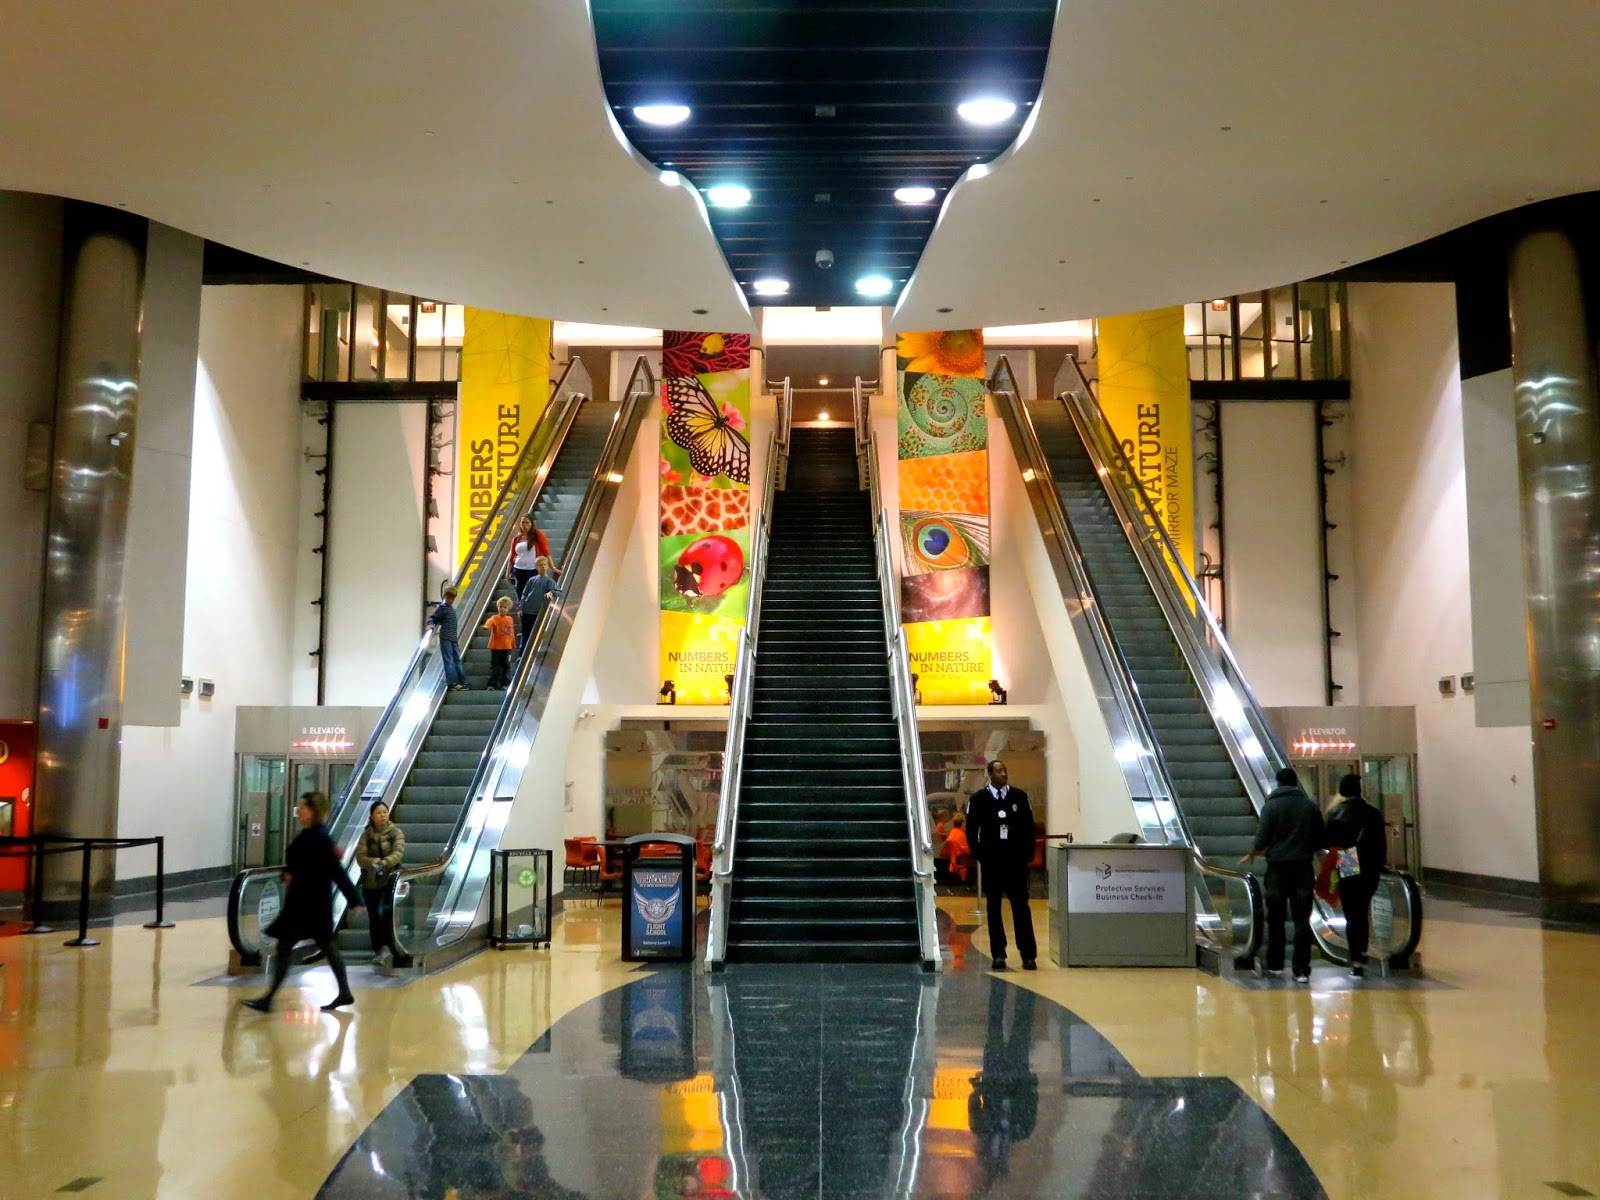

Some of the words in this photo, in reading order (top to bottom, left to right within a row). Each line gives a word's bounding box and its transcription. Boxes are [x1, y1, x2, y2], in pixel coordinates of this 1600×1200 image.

[1165, 446, 1178, 487] MAZE
[668, 651, 729, 662] NUMBERS
[909, 651, 969, 662] NUMBERS
[678, 663, 692, 673] IN
[695, 663, 736, 673] NATUR
[920, 663, 933, 673] IN
[936, 662, 985, 673] NATURE
[309, 726, 346, 735] ELEVATOR
[1309, 727, 1346, 736] ELEVATOR
[1095, 884, 1133, 892] Protective
[1134, 884, 1166, 892] Services
[1095, 893, 1129, 901] Business
